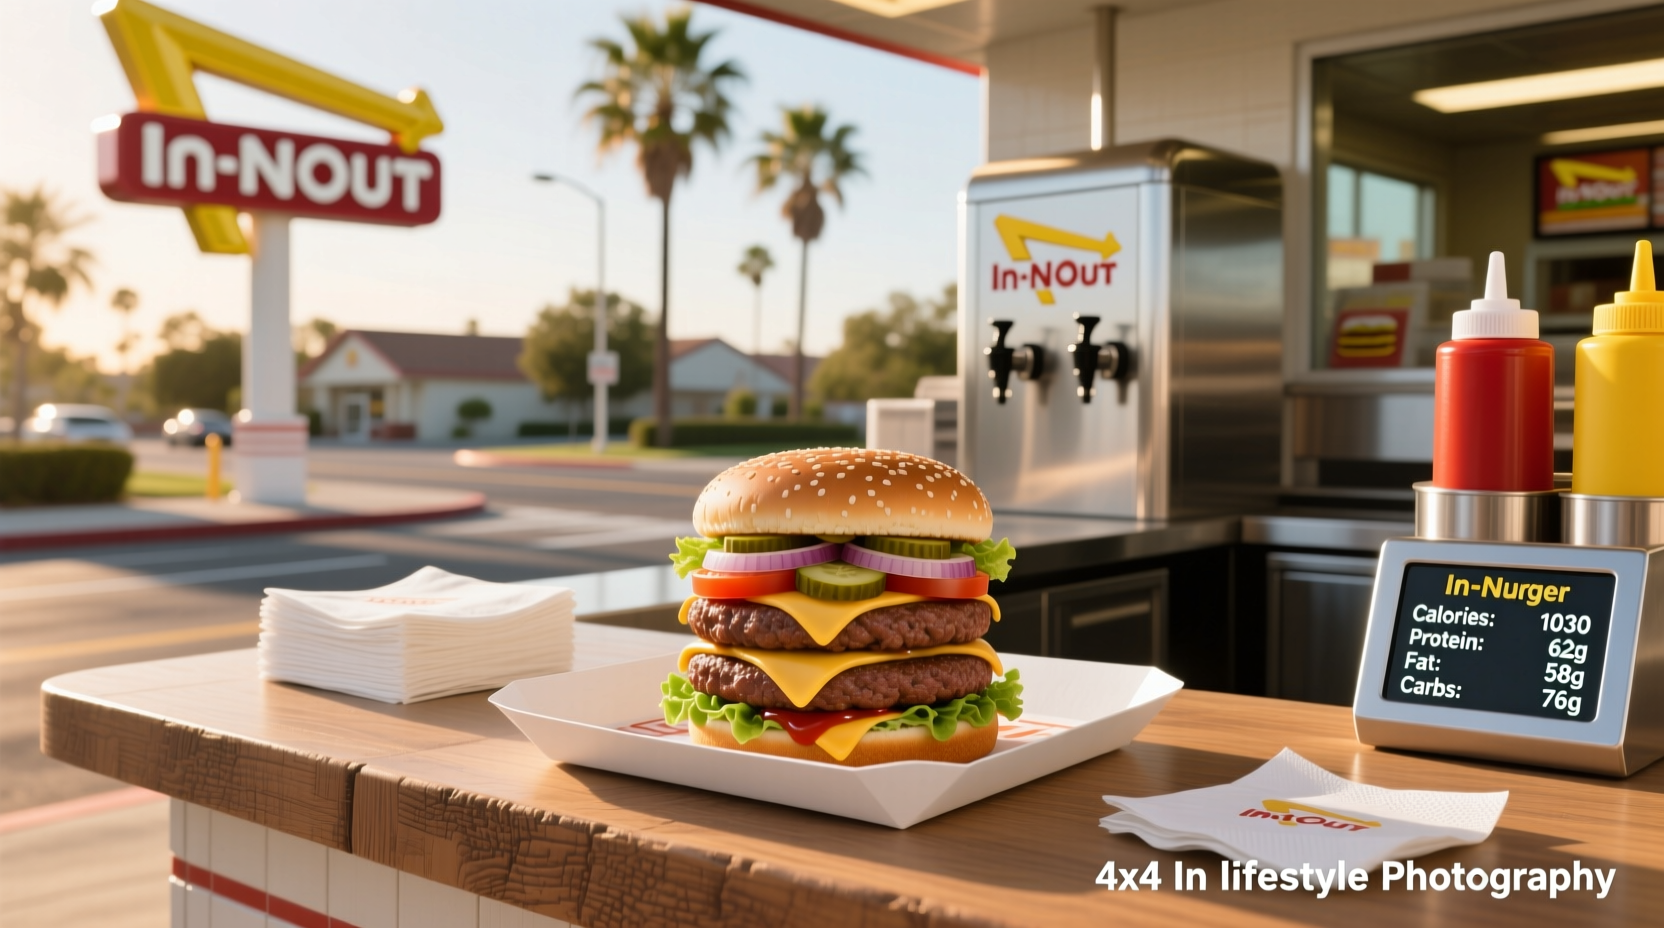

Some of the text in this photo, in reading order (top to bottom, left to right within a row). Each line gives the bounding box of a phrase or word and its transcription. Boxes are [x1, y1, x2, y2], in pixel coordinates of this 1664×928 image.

[141, 121, 434, 213] In-NOUT
[1445, 574, 1570, 606] In-Nurger
[1412, 604, 1591, 634] Calories: 1030
[1409, 628, 1588, 664] Protein: 62g
[1404, 651, 1584, 690] Fat: 58g
[1400, 675, 1582, 716] Carbs: 76g
